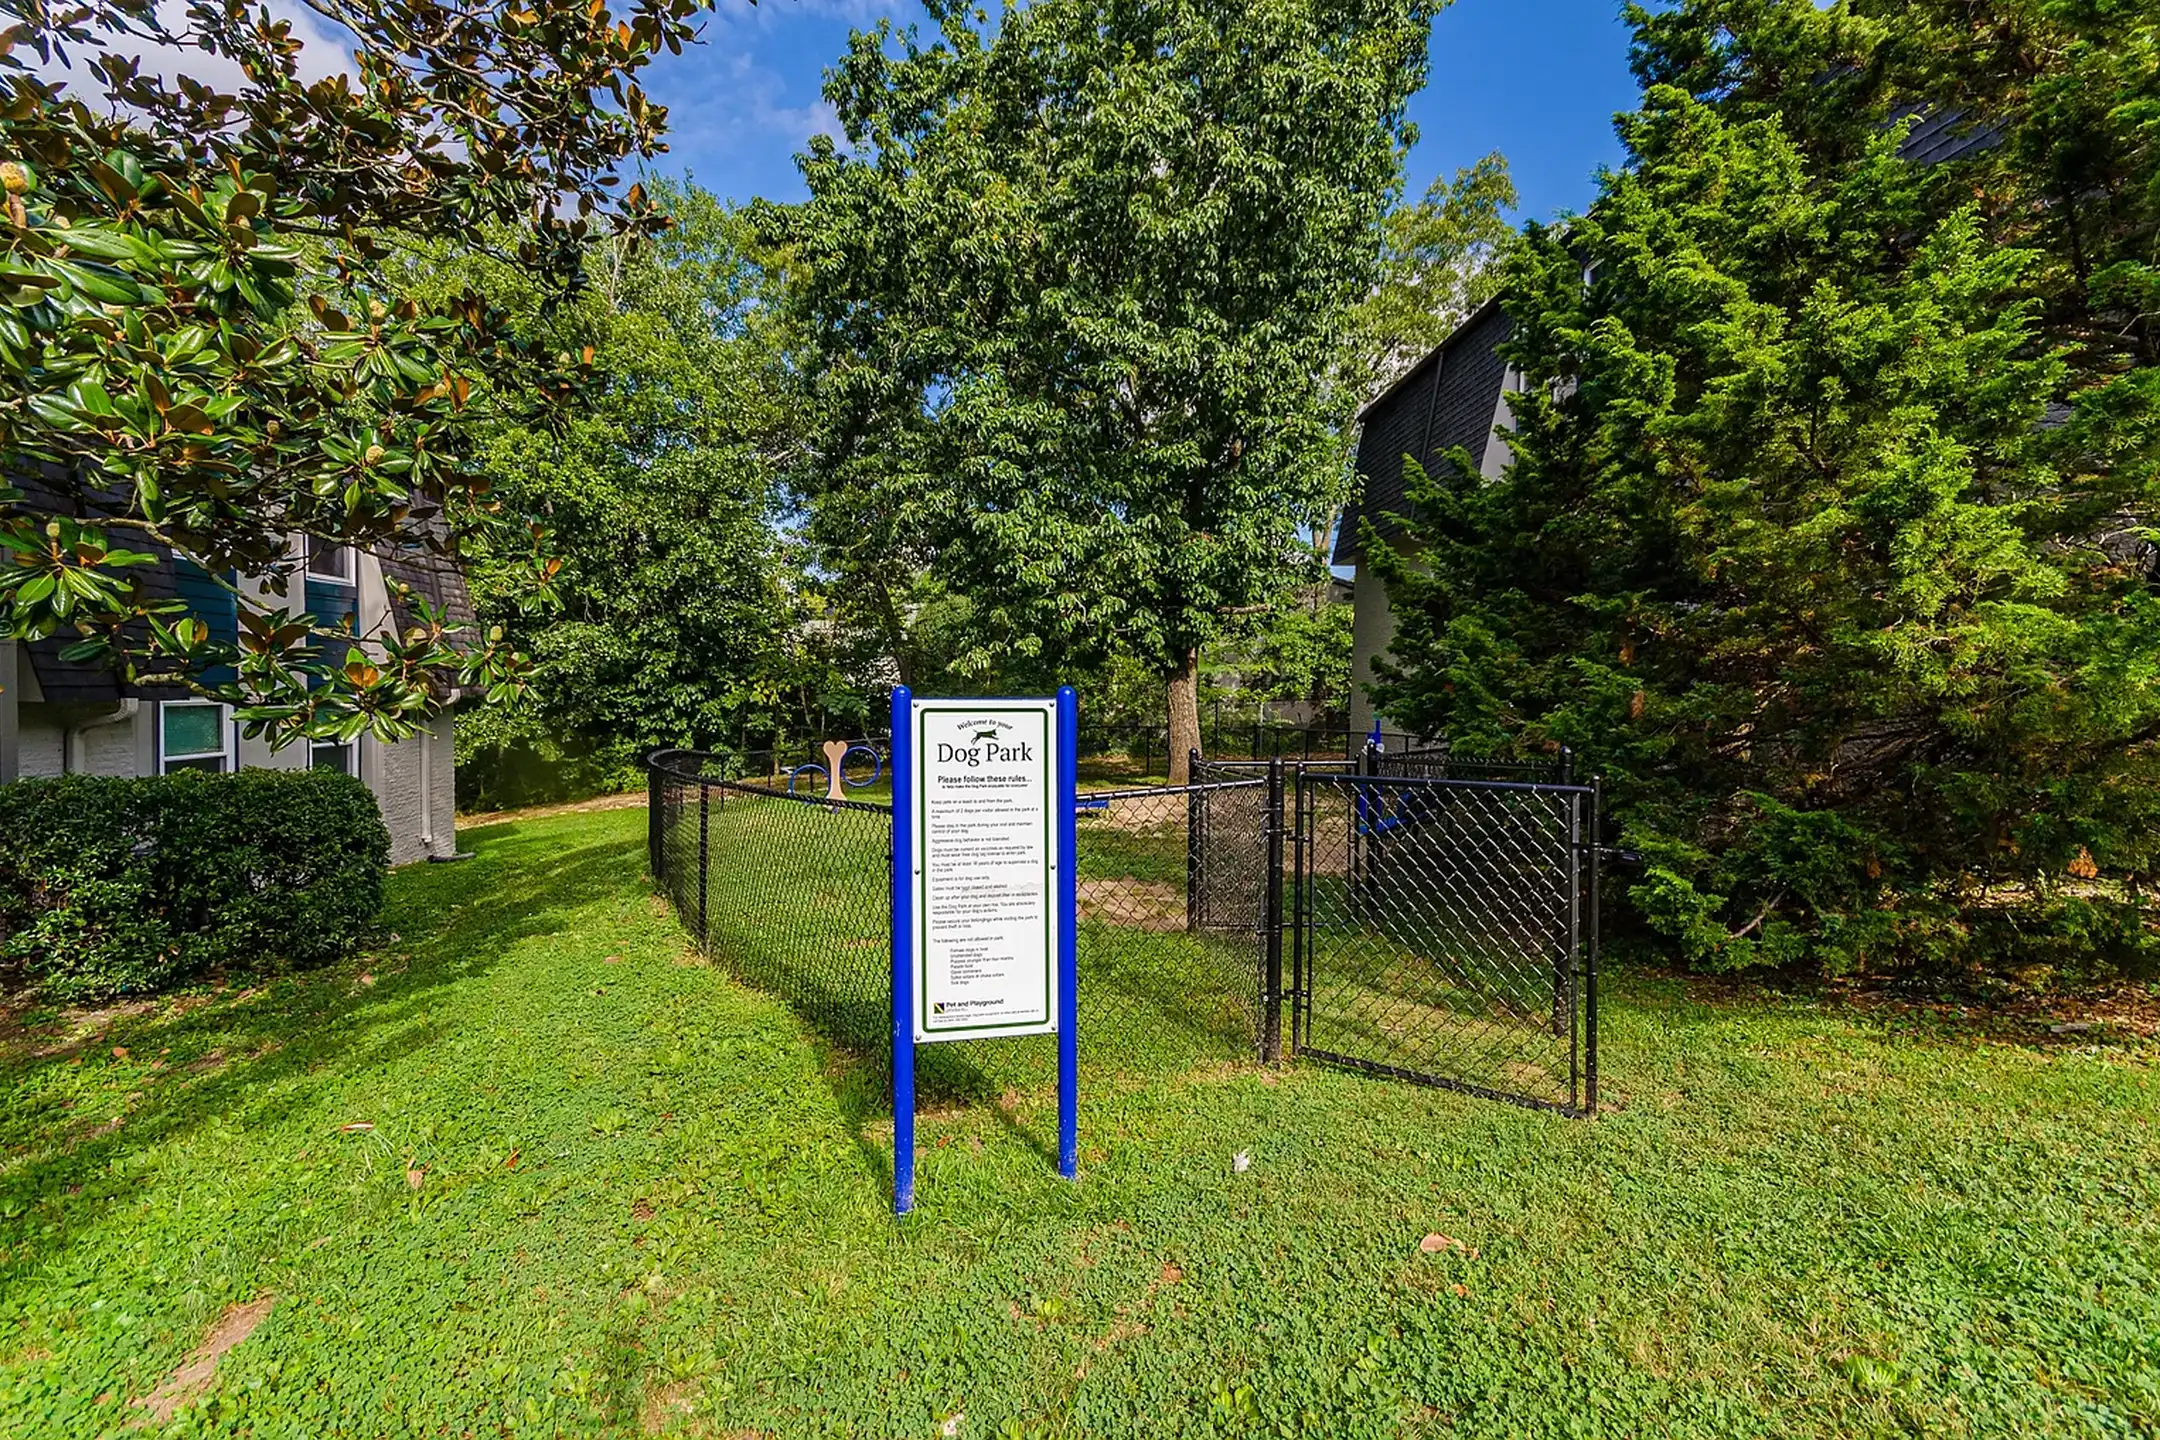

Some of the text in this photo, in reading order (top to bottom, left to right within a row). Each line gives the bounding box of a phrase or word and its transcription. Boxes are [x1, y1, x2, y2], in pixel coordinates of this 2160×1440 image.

[956, 720, 988, 730] Welcome
[996, 721, 1013, 730] your
[937, 742, 1033, 767] Dog Park
[938, 775, 962, 784] Please
[963, 775, 986, 783] follow
[970, 999, 1004, 1007] Playground
